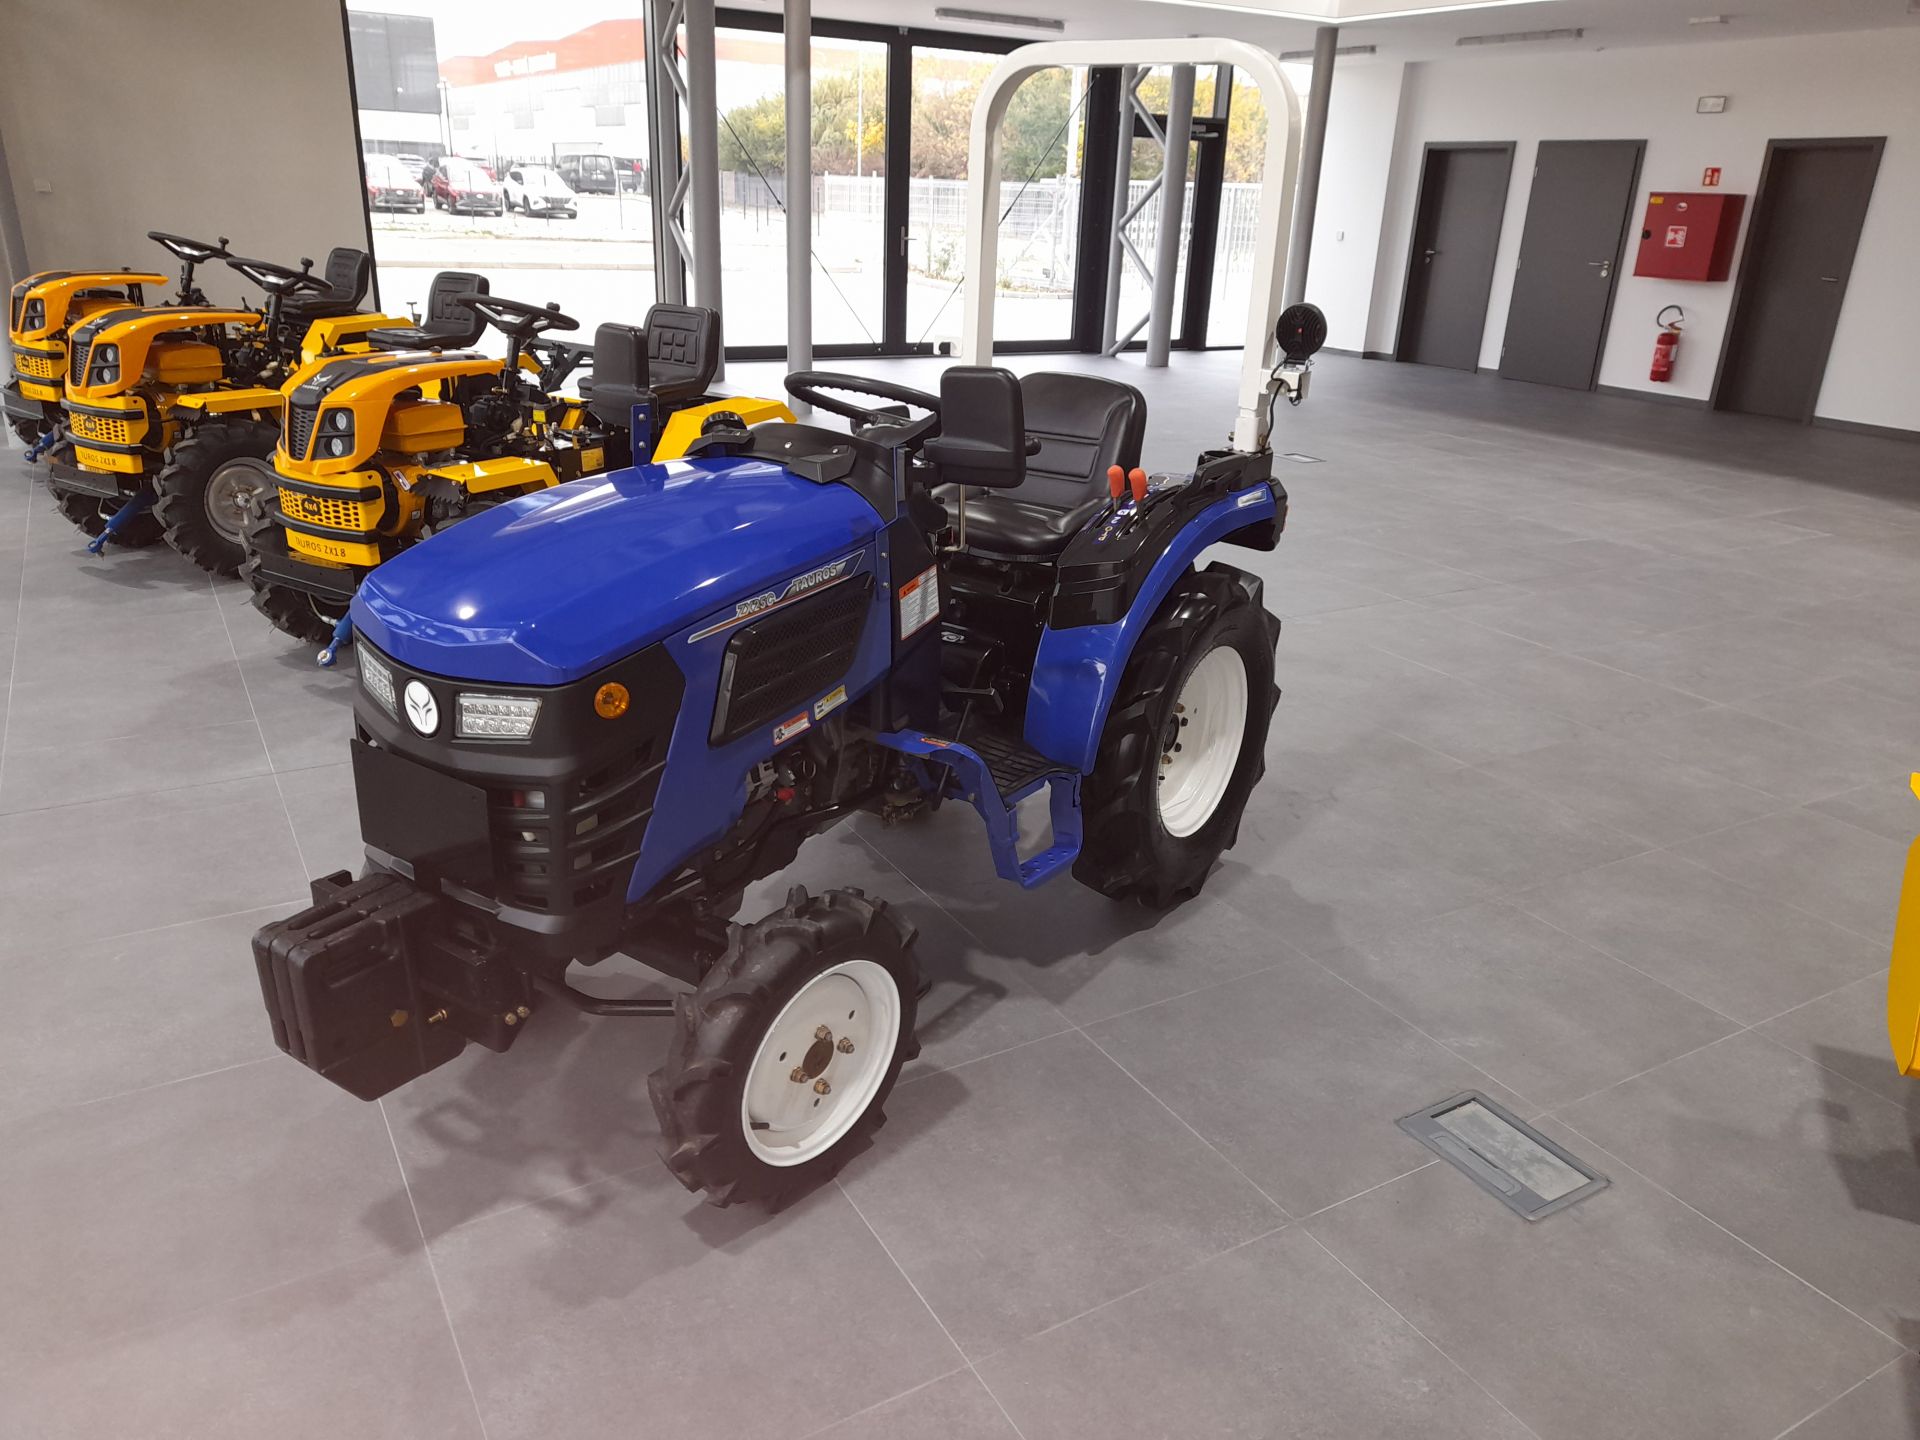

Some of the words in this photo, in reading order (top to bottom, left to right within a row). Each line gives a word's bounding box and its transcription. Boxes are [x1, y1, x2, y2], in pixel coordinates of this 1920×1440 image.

[303, 501, 318, 512] 4x4
[324, 545, 346, 557] ZX18
[793, 563, 837, 592] TAUROS
